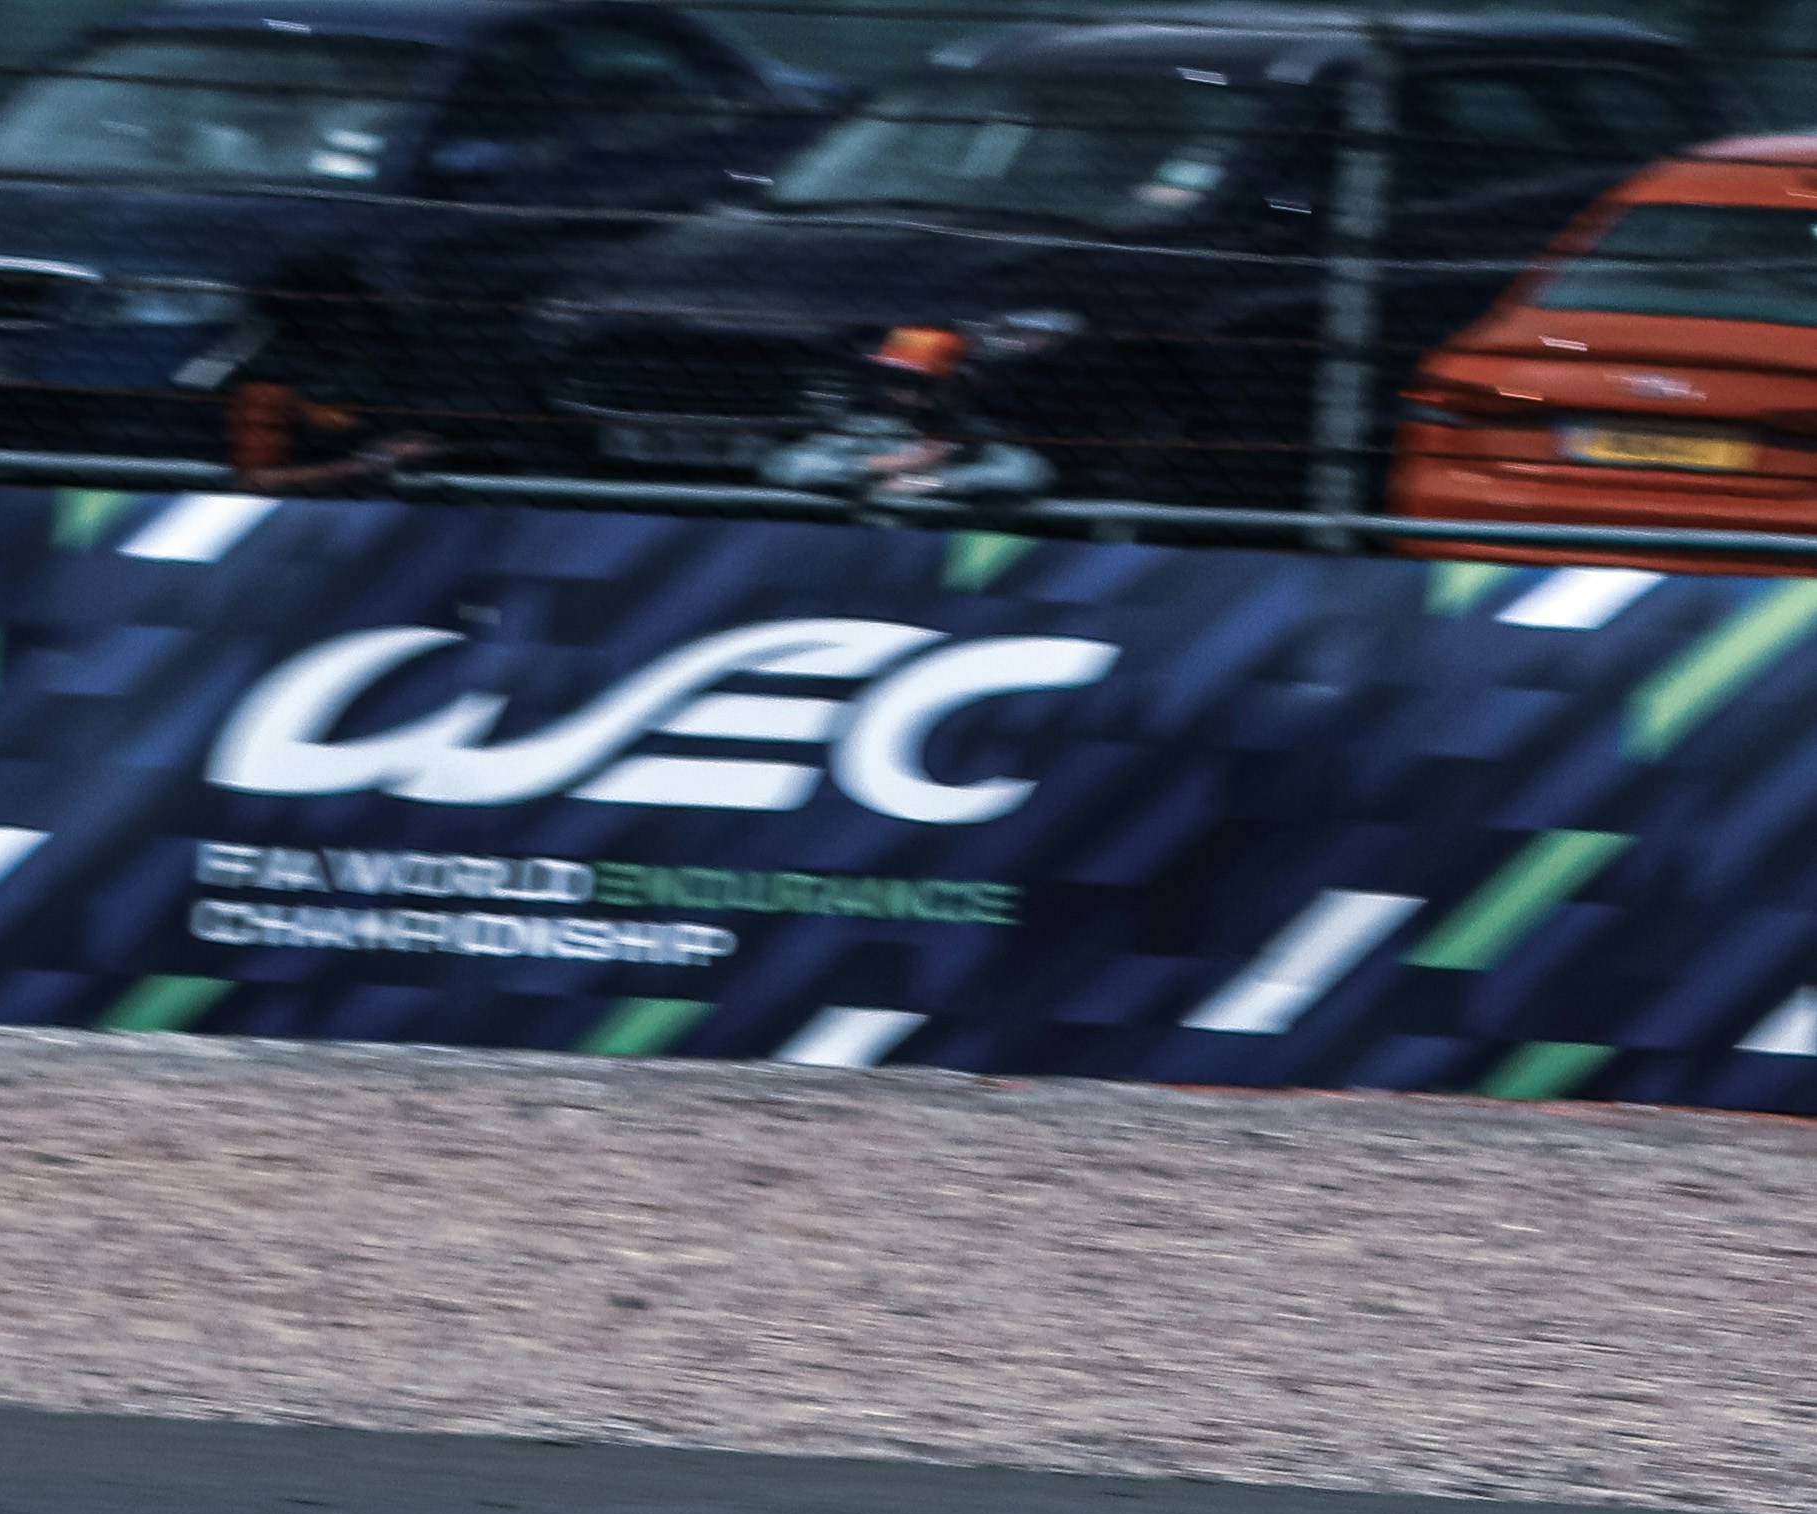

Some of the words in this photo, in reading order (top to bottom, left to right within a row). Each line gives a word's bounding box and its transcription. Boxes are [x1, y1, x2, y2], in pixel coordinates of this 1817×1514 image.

[206, 617, 1122, 824] WEC
[321, 846, 596, 906] WORLD
[592, 859, 1026, 927] ENDURANCE
[188, 897, 739, 968] CHAMPIONSHIP
